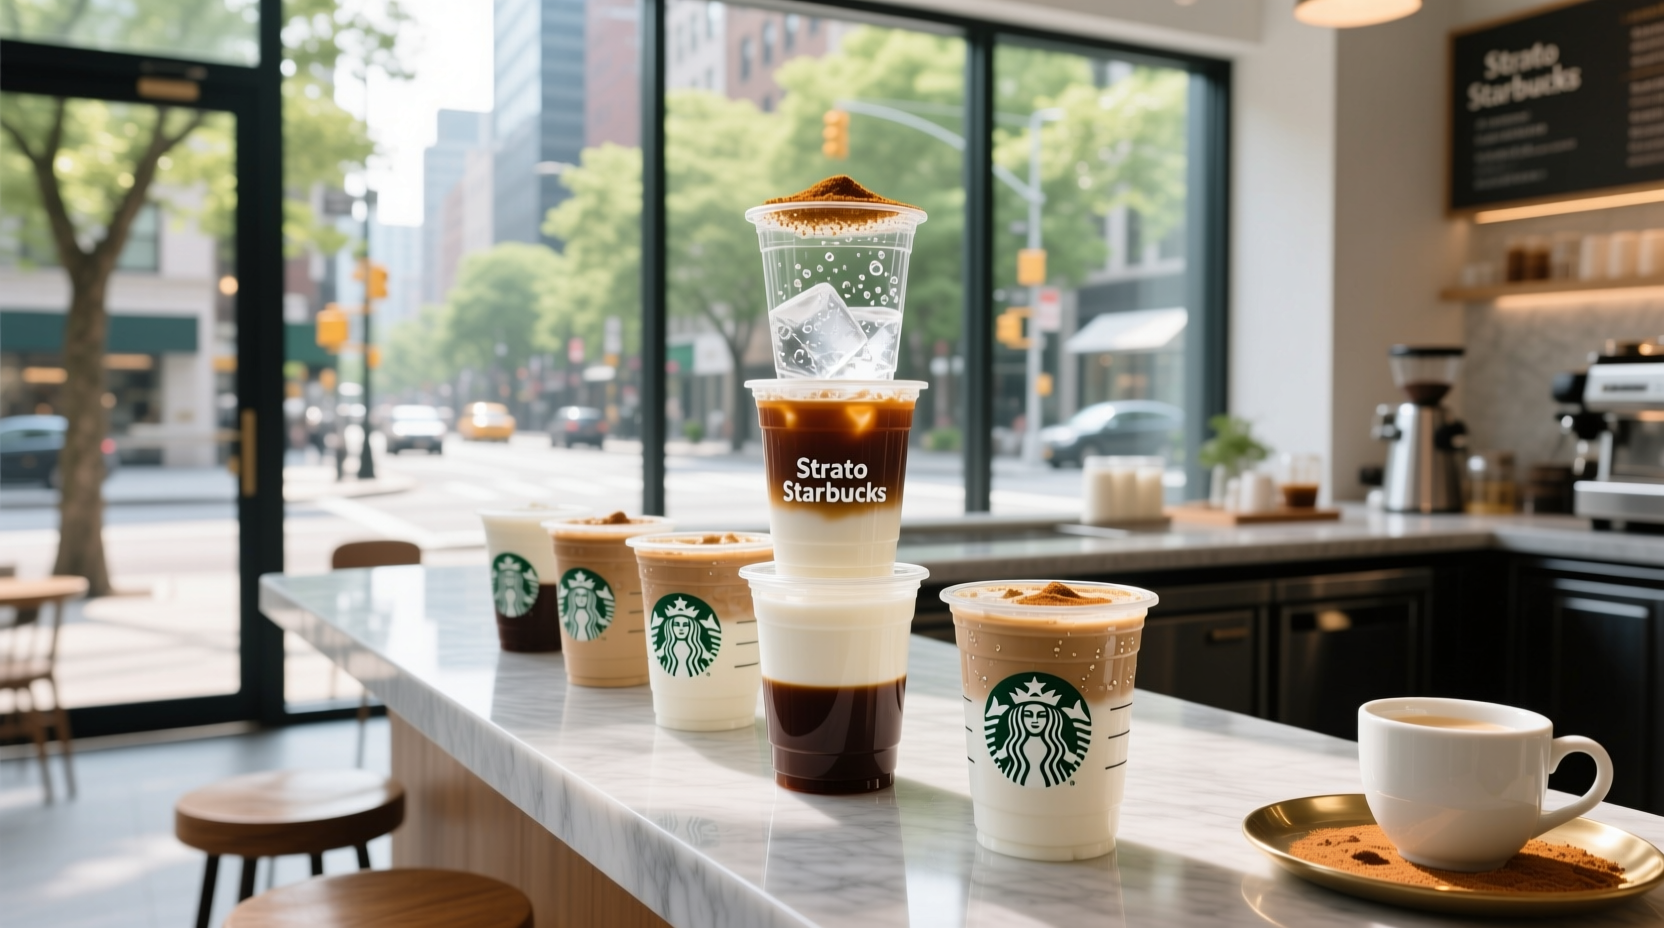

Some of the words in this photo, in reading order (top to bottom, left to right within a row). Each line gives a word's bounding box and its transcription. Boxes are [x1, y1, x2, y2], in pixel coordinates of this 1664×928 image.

[1484, 42, 1559, 79] Strato
[1467, 65, 1582, 110] Starbucks
[797, 457, 868, 479] Strato
[783, 480, 887, 503] Starbucks
